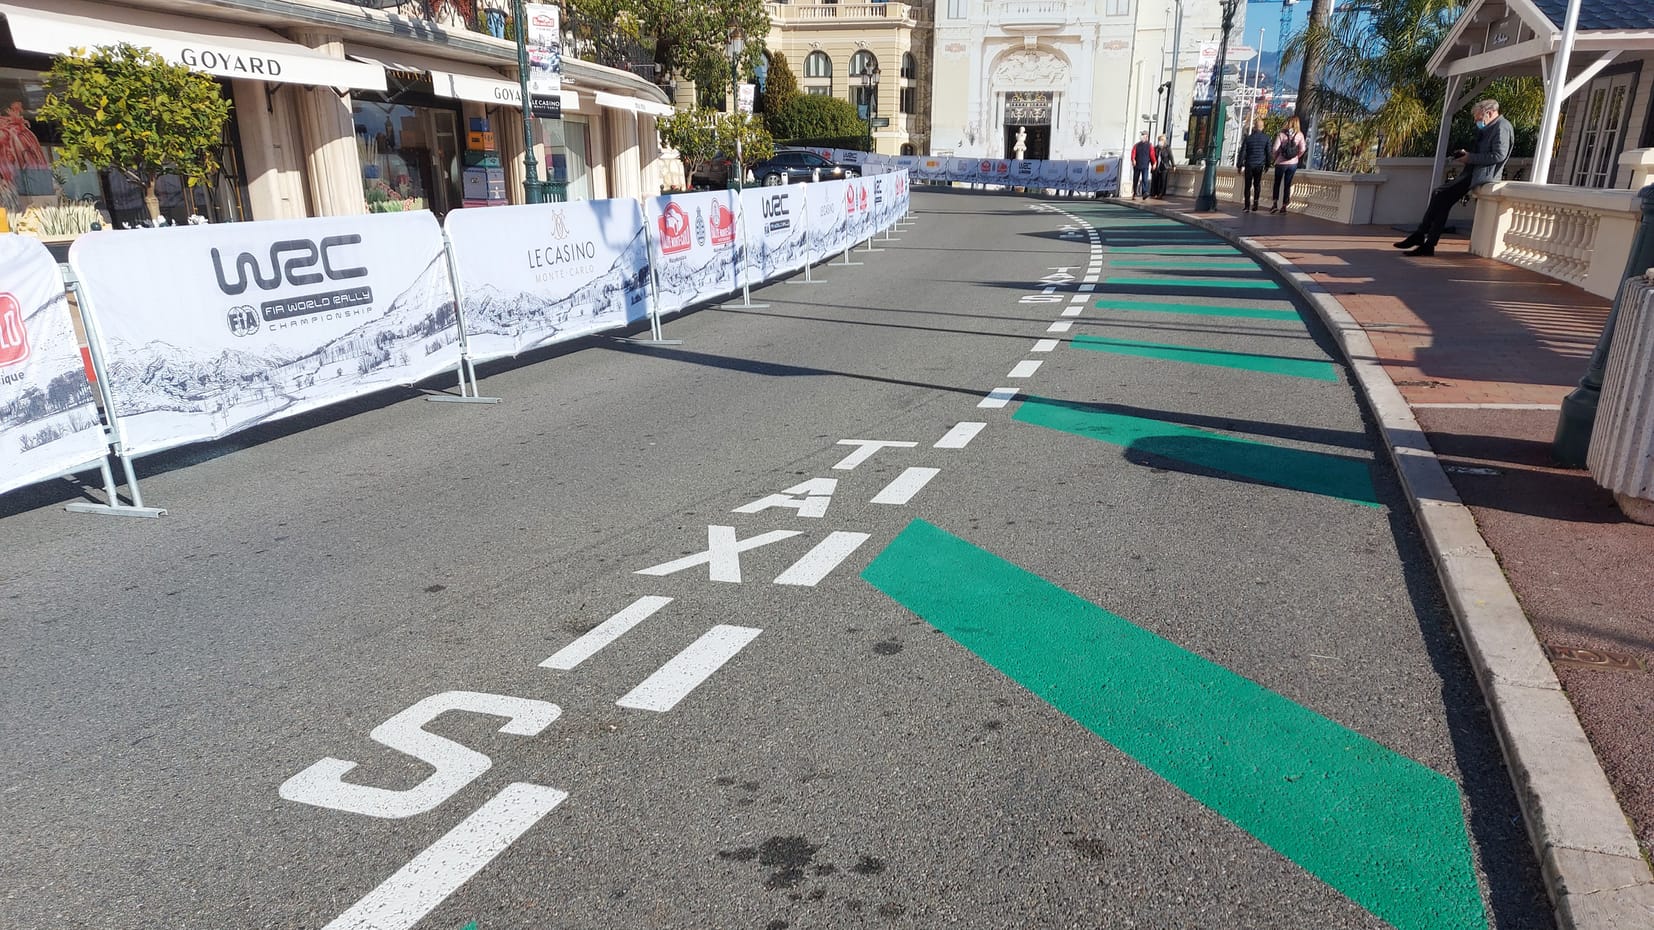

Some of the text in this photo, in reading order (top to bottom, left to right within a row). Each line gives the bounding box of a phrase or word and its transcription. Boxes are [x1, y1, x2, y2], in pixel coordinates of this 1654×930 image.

[181, 48, 282, 76] GOYARD
[494, 87, 522, 102] GOYA
[761, 193, 790, 218] WRC
[211, 234, 368, 296] WRC
[527, 241, 596, 269] LE CASINO
[264, 291, 370, 316] FIA WORLD RALLY
[268, 306, 373, 332] CHAMPIONSHIP
[279, 439, 919, 819] TAXIS
